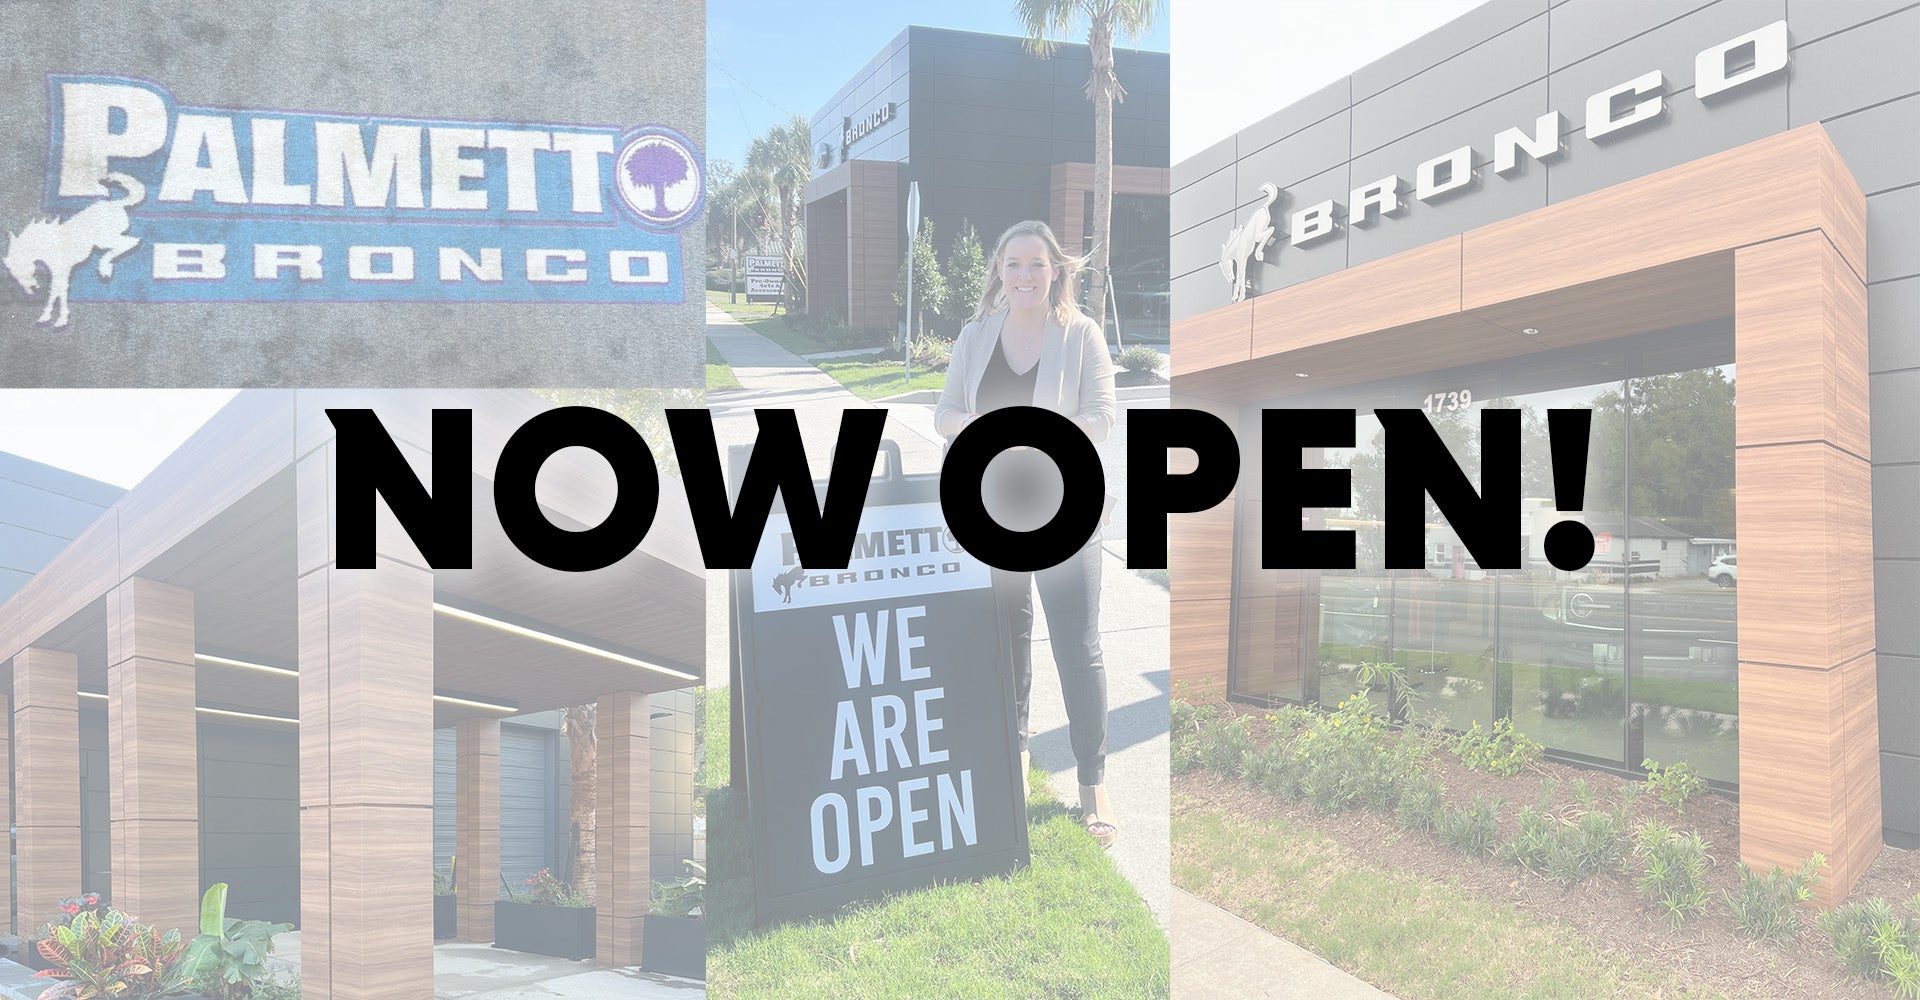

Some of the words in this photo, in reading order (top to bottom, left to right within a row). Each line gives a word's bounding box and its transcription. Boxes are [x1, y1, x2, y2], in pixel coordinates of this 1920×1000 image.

[845, 102, 890, 145] BRONCO
[1290, 19, 1789, 247] BRONCO
[152, 242, 670, 284] BRONCO
[1424, 389, 1472, 413] 1739
[809, 562, 961, 587] BRONCO
[832, 605, 931, 689] WE
[830, 687, 949, 780] ARE
[810, 769, 978, 875] OPEN
